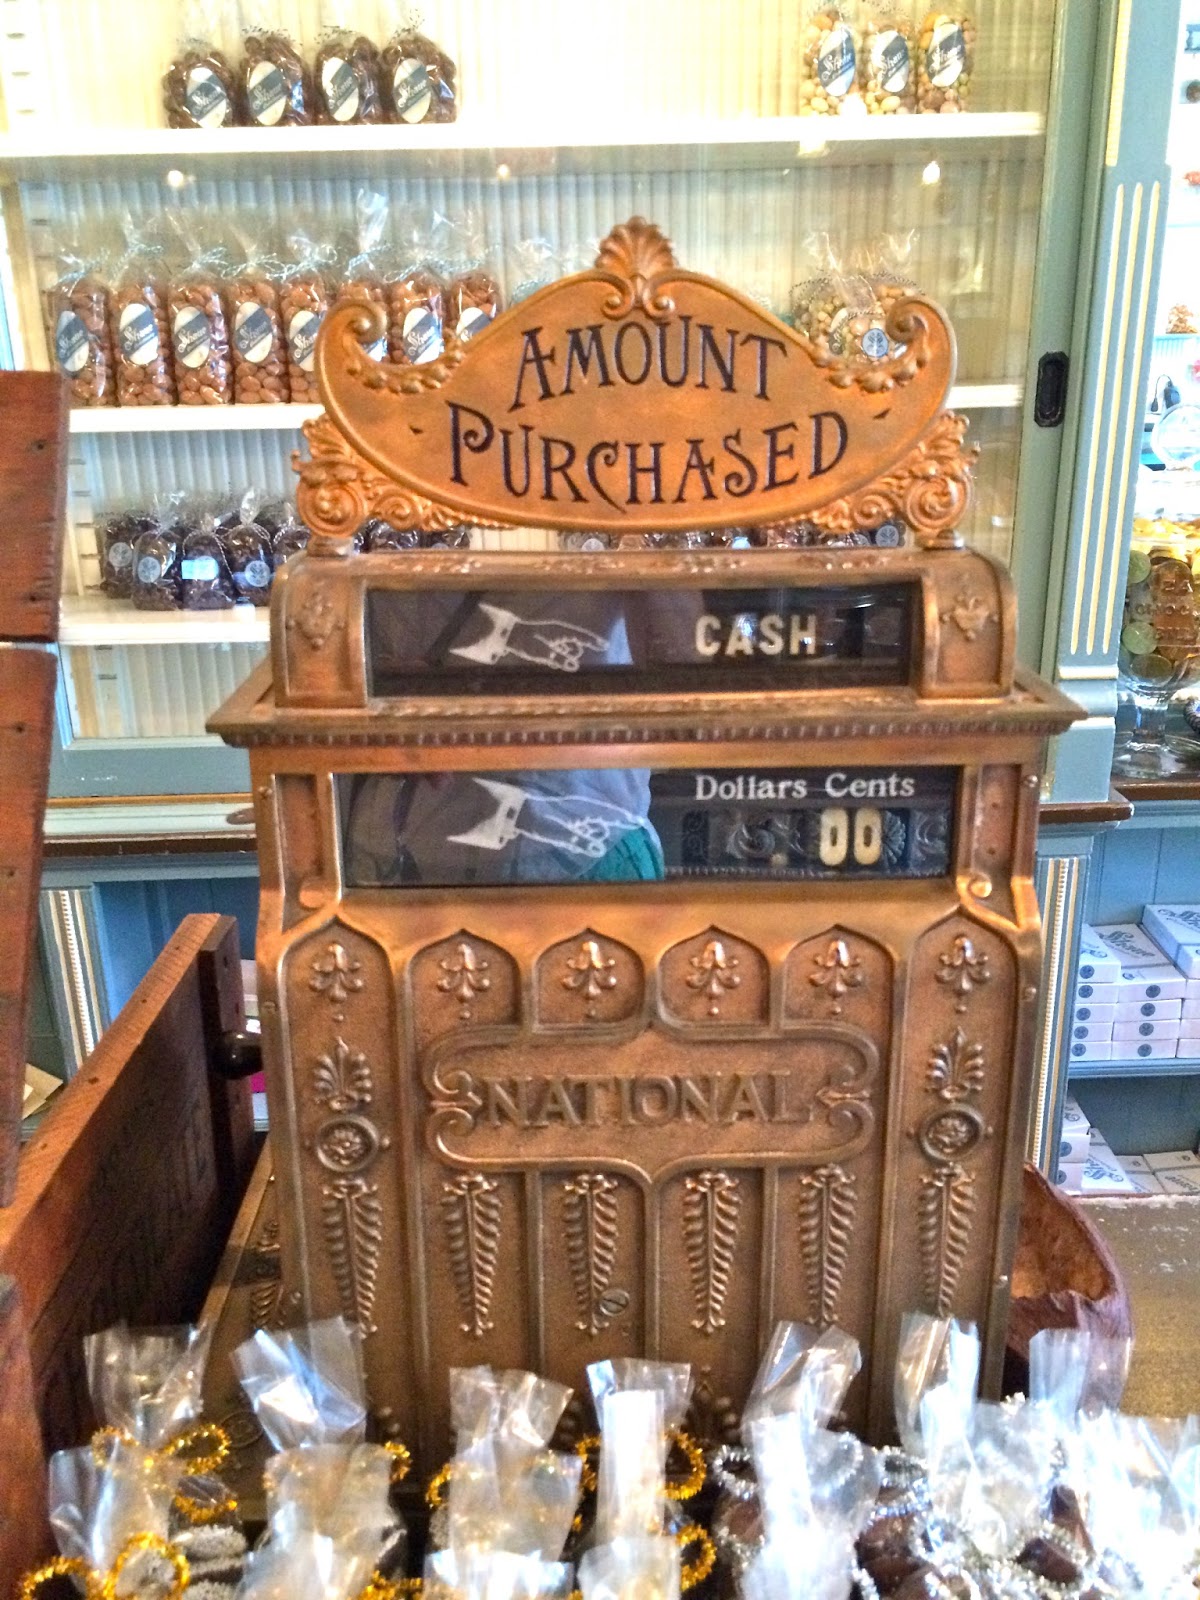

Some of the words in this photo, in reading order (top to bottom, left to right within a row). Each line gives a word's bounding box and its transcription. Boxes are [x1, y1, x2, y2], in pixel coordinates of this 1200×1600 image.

[508, 315, 788, 413] AMOUNT
[445, 400, 849, 514] PURCHASED
[695, 613, 817, 658] CASH
[695, 774, 808, 801] Dollars
[825, 772, 916, 798] Cents
[486, 1070, 814, 1128] NATIONAL
